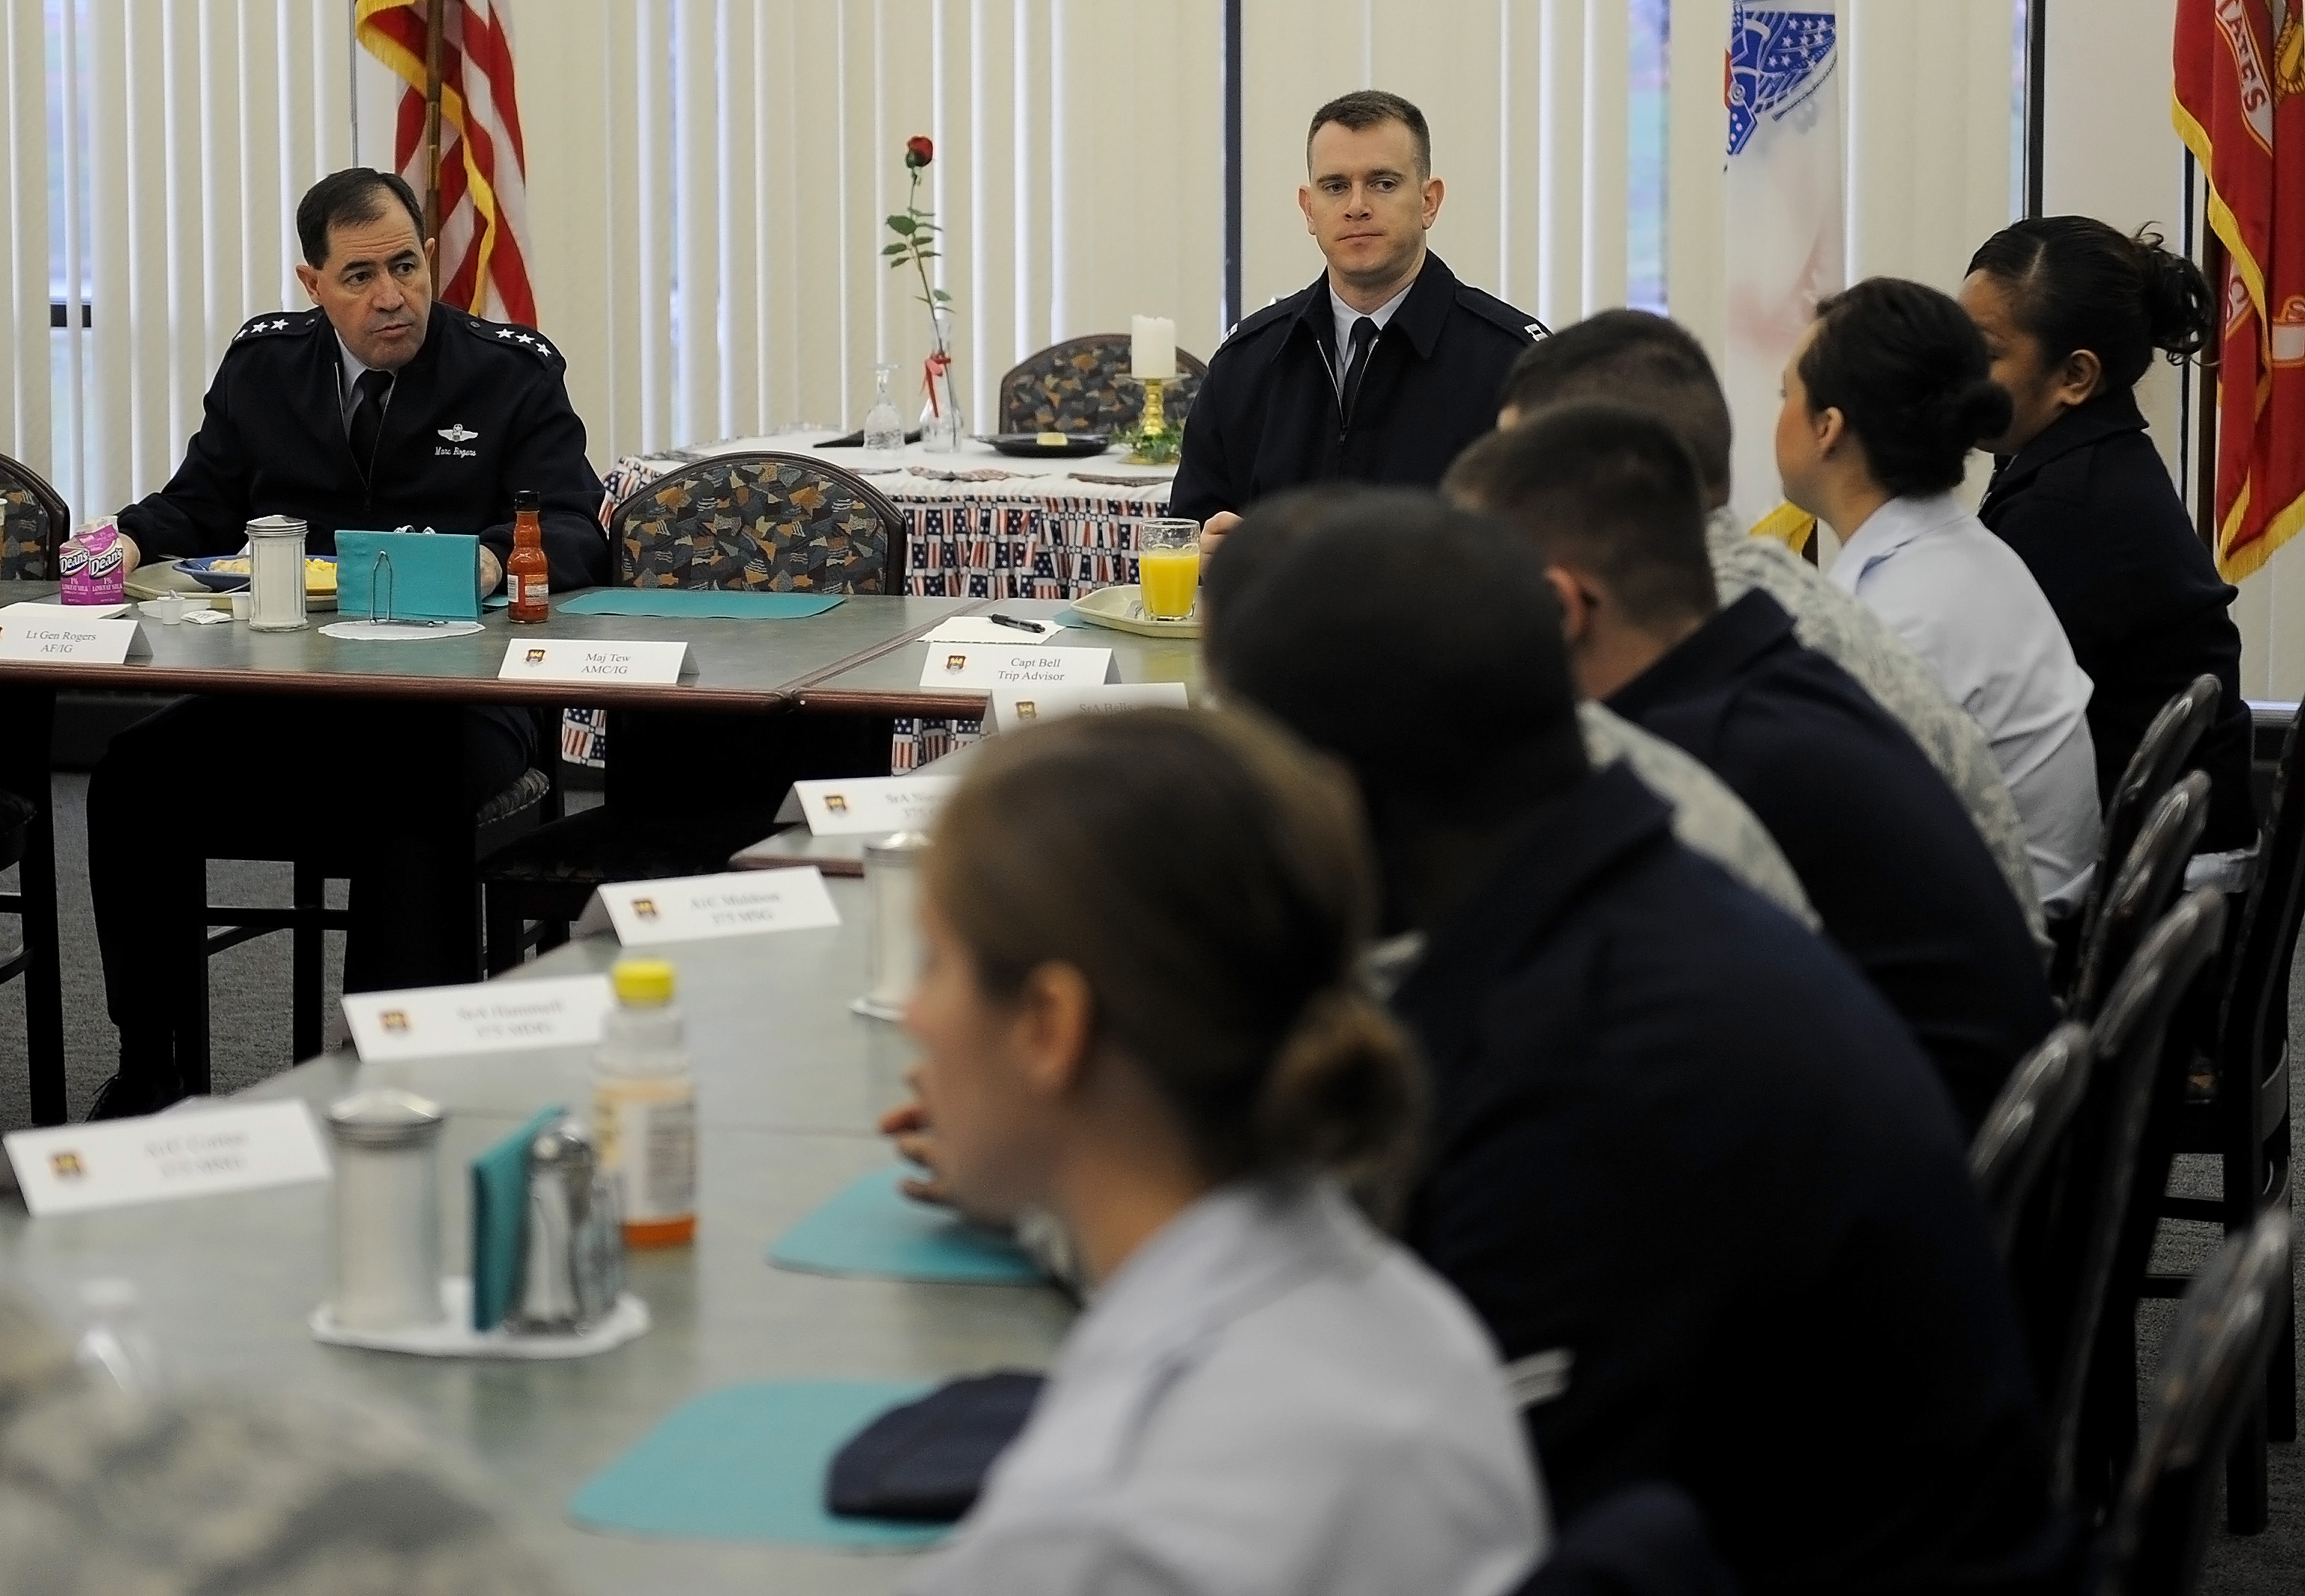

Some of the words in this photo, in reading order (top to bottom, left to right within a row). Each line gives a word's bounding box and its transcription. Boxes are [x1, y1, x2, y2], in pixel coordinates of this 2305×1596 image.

[60, 549, 89, 576] Dean's
[90, 547, 123, 578] Dean's
[25, 630, 37, 640] Lt
[40, 631, 61, 640] Gen
[62, 631, 97, 643] Rogers
[40, 643, 74, 654] AF/IG
[585, 653, 607, 664] Maj
[610, 654, 631, 662] Tew
[1010, 658, 1036, 669] Capt
[1039, 658, 1061, 668] Bell
[581, 665, 628, 675] AMC/IG
[997, 670, 1020, 681] Trip
[1021, 672, 1065, 681] Advisor
